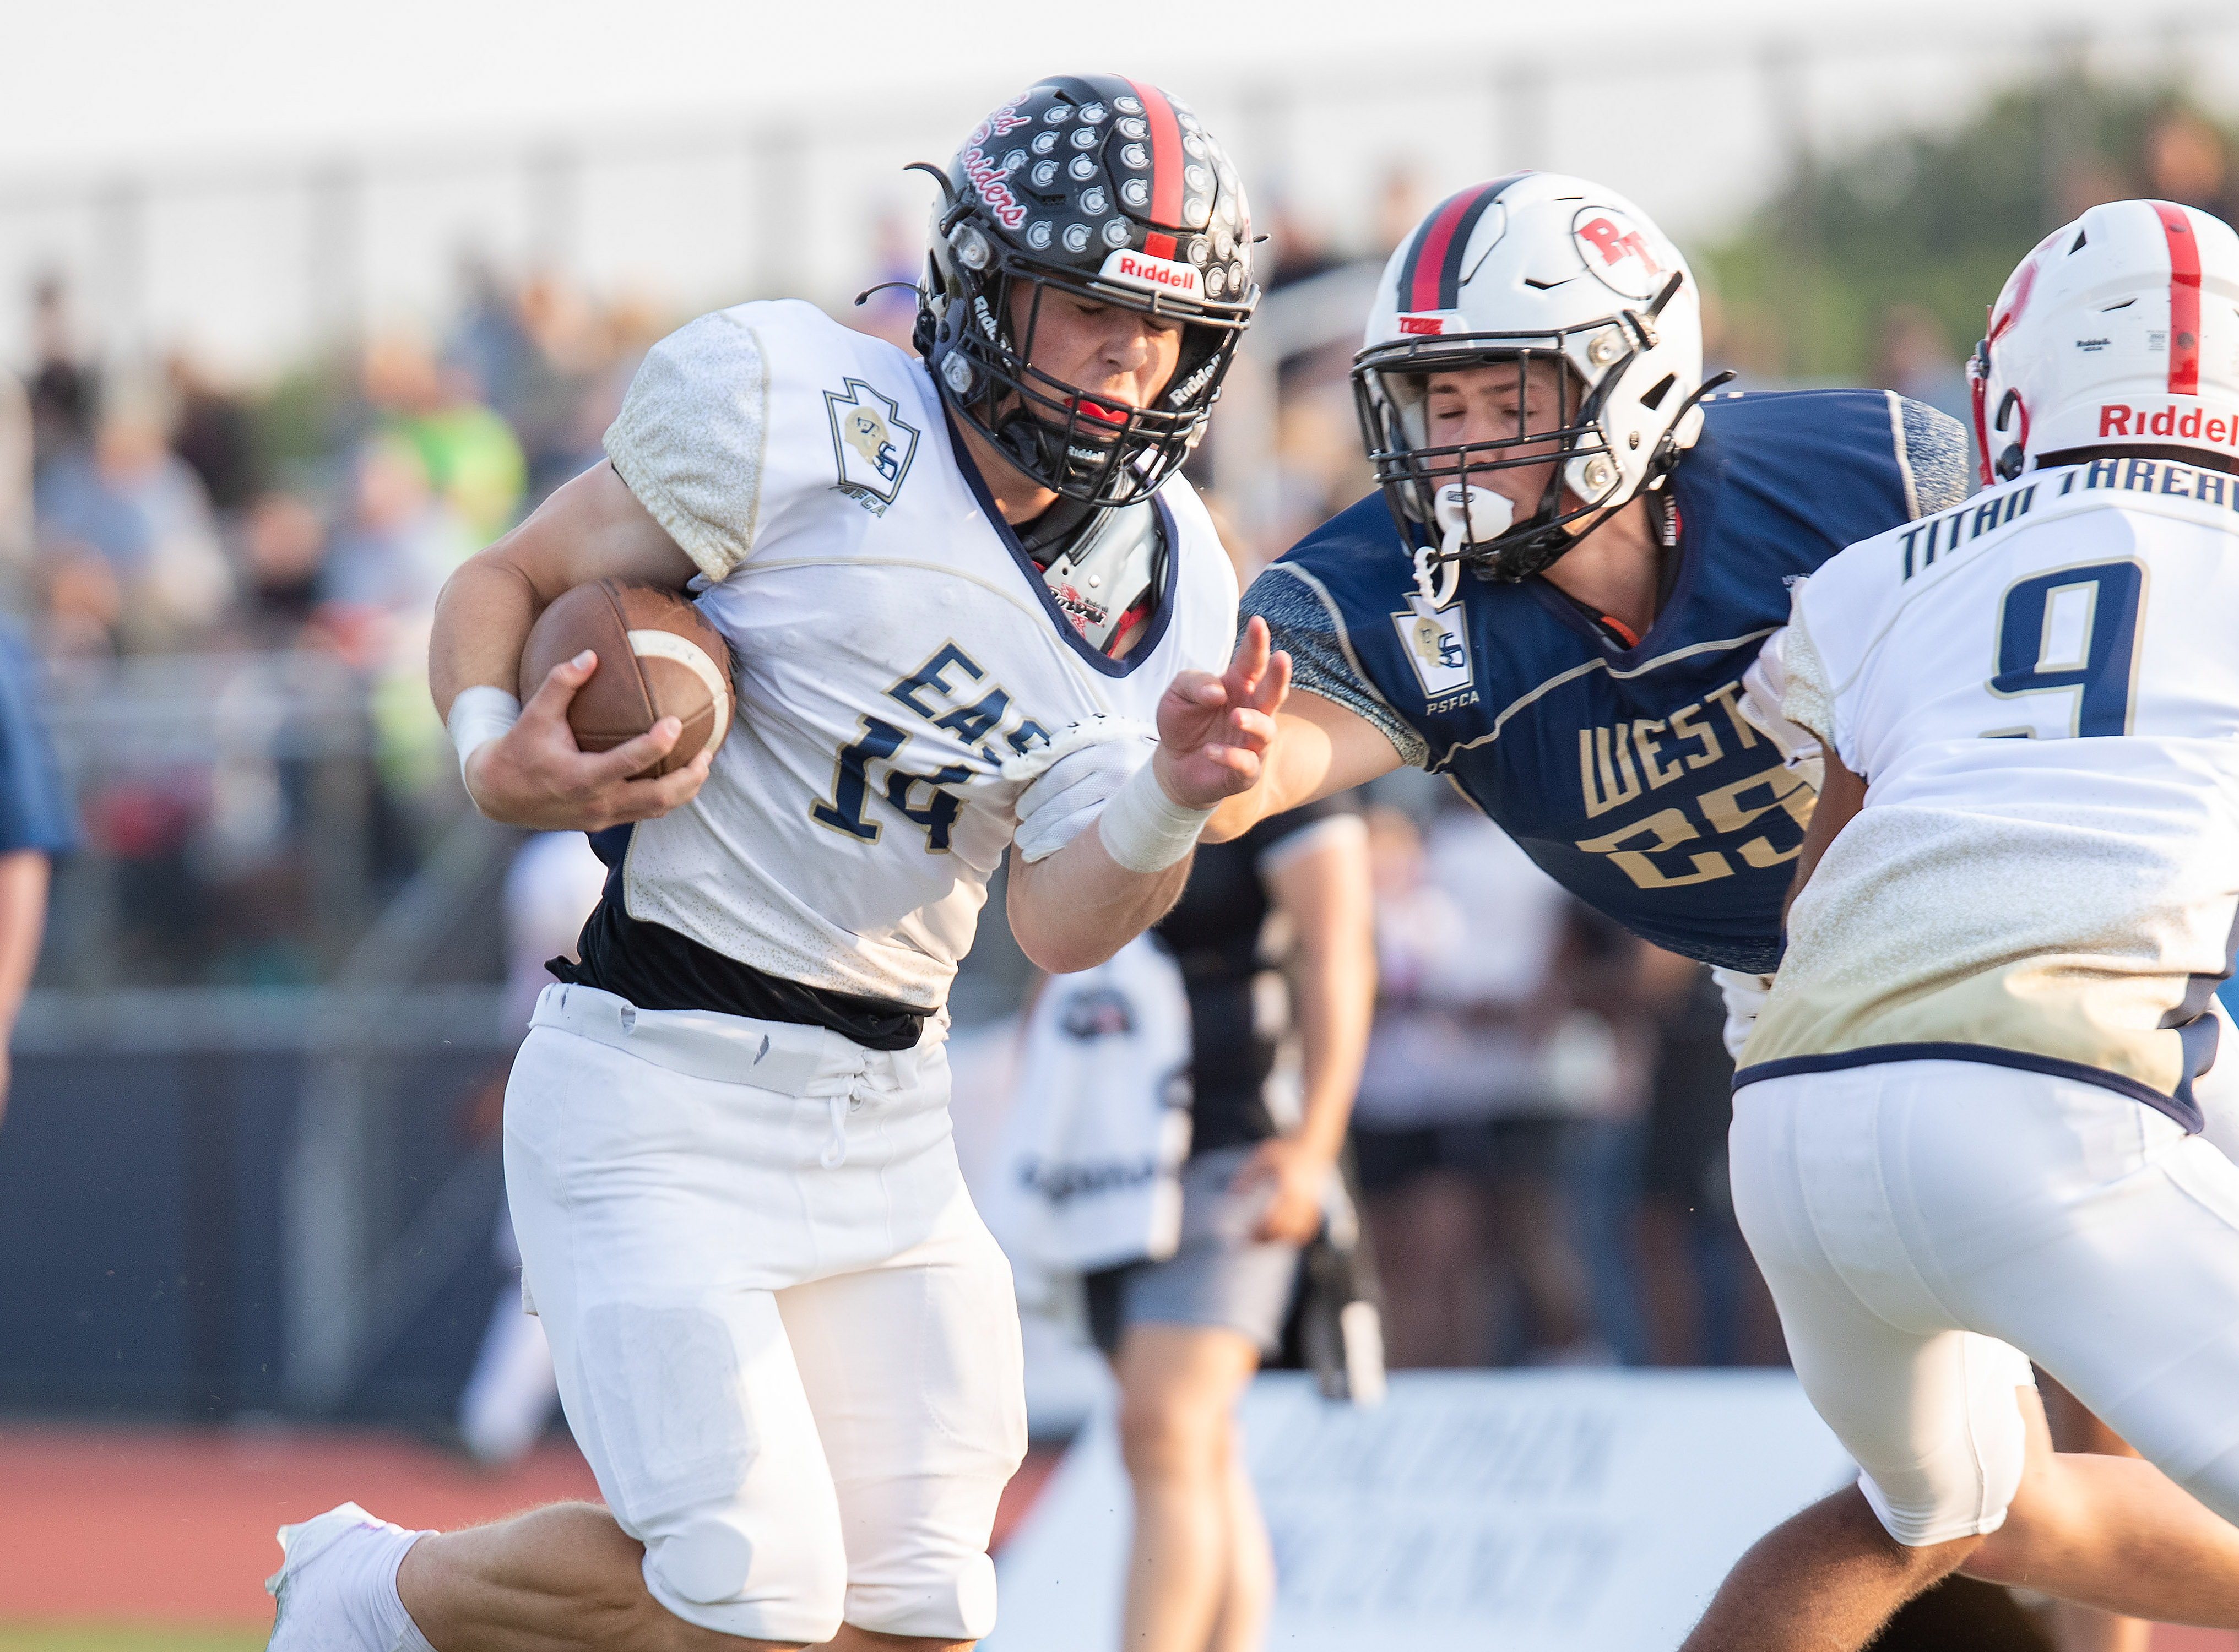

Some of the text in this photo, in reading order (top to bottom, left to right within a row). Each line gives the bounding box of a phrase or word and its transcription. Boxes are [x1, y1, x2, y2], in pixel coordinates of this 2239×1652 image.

[962, 119, 1028, 229] Raiders
[1120, 257, 1194, 290] Riddell
[2099, 404, 2239, 447] Riddel
[881, 637, 1051, 769] EAS
[1426, 690, 1481, 716] PSFCA
[1978, 555, 2151, 740] 9
[808, 714, 980, 855] 14
[1579, 680, 1758, 819] WEST
